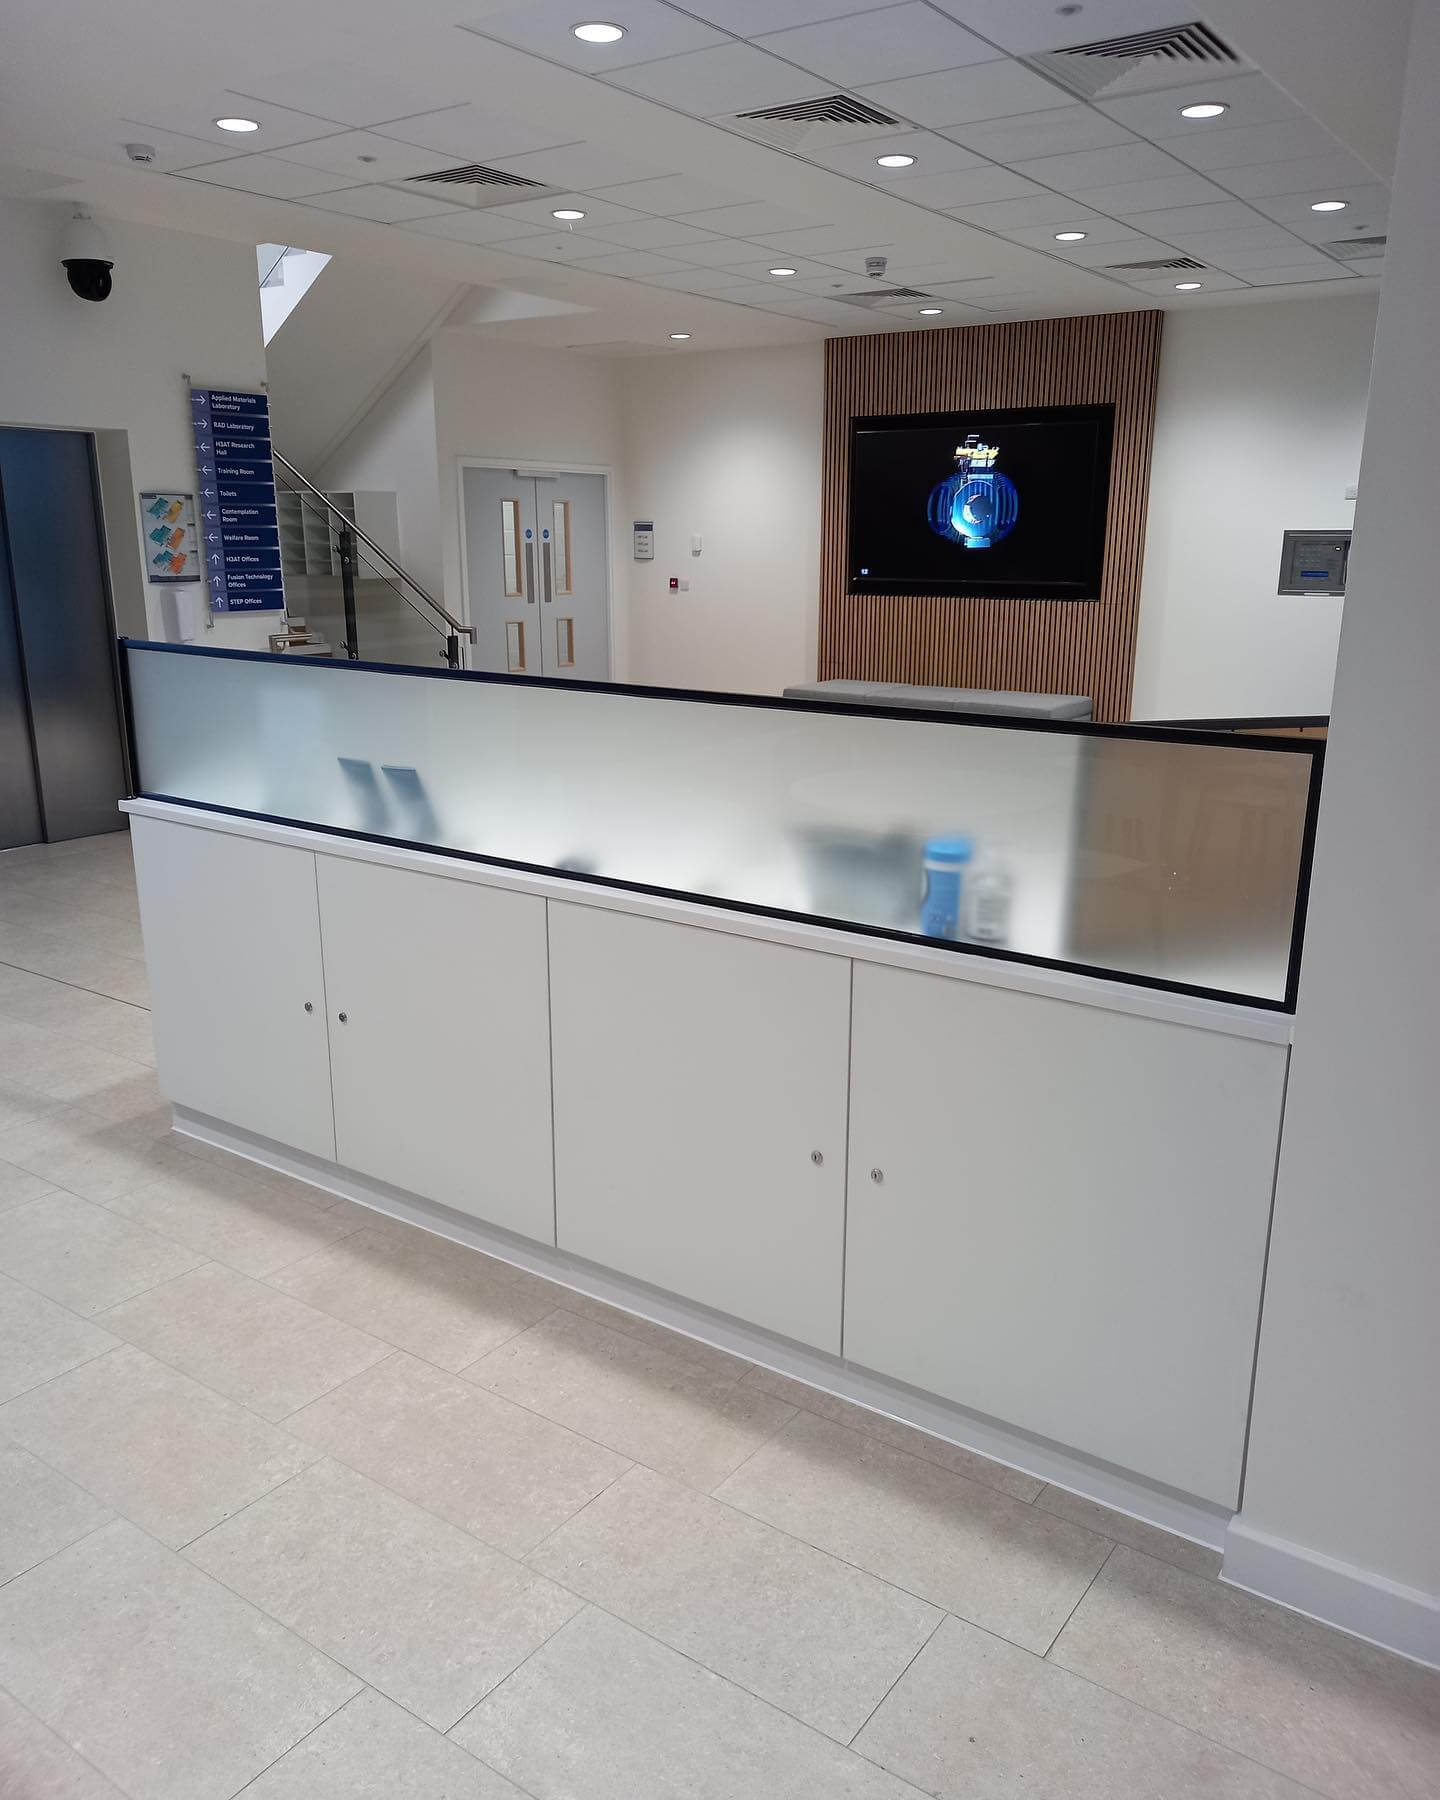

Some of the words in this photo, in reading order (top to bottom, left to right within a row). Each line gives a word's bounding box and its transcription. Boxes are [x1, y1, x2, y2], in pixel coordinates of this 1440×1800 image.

[211, 394, 232, 403] Applied
[233, 396, 256, 404] Materials
[212, 403, 240, 412] Laboratory
[226, 422, 255, 432] Laboratory
[217, 468, 238, 476] Training
